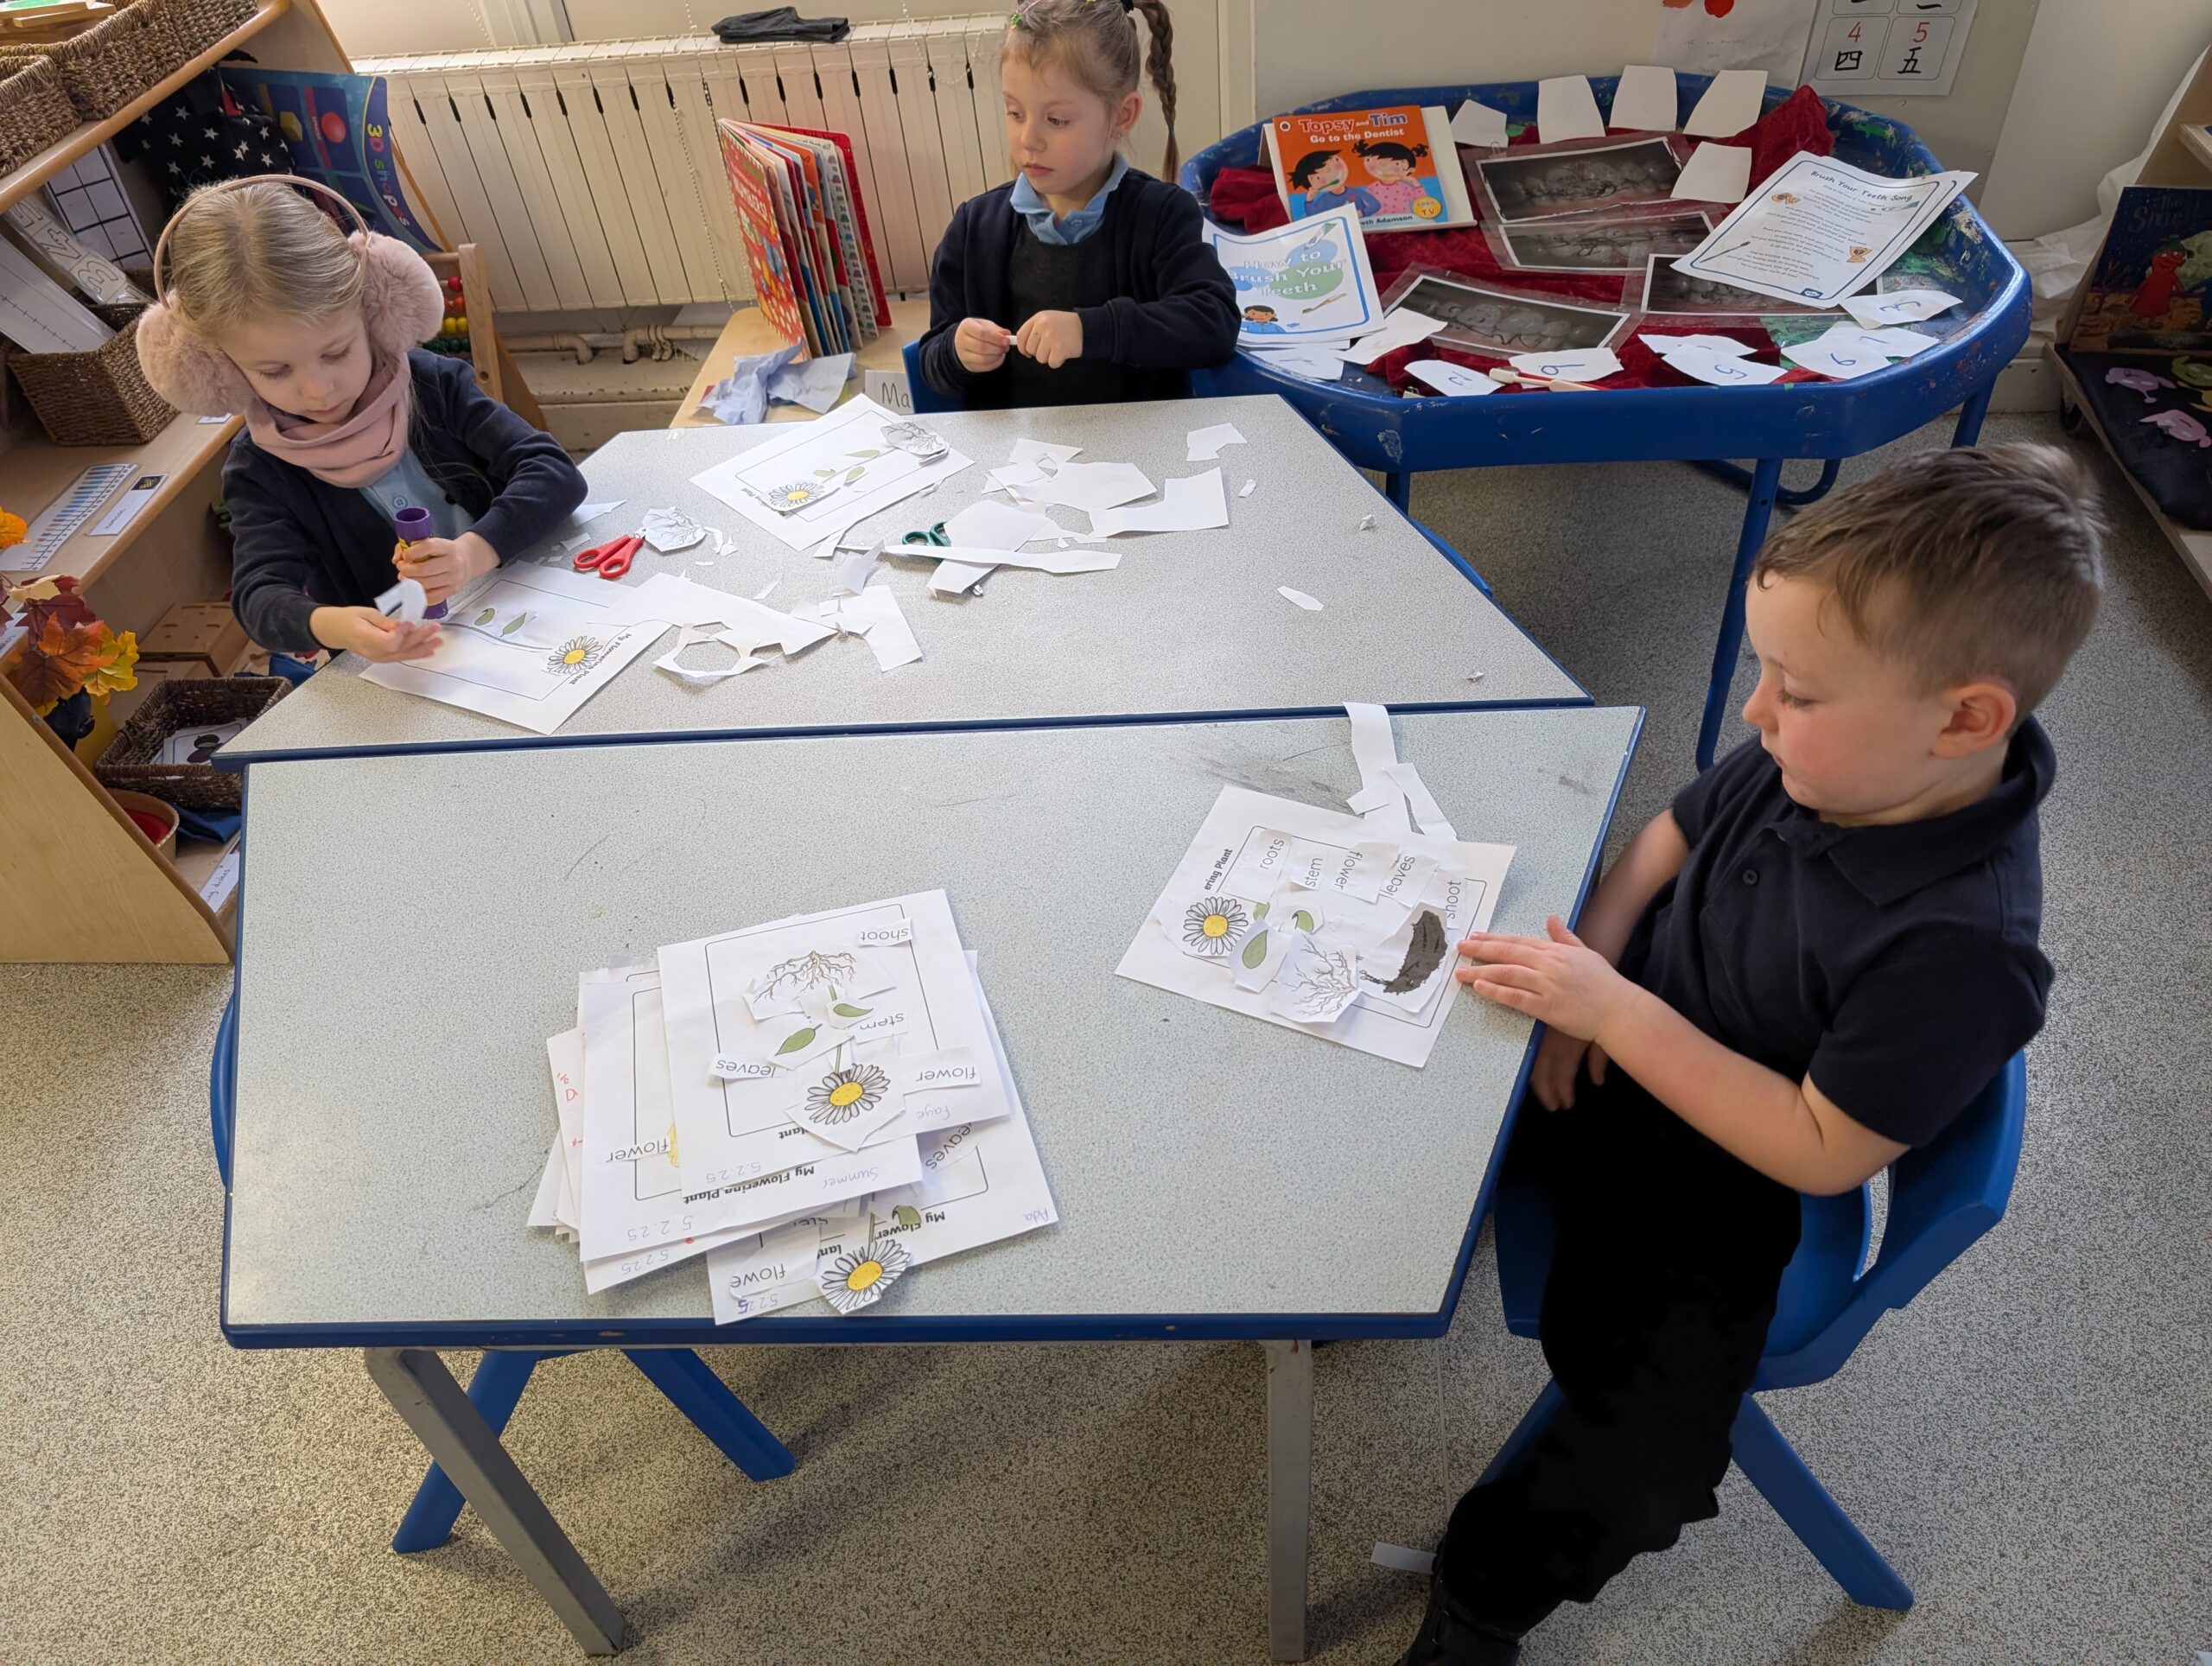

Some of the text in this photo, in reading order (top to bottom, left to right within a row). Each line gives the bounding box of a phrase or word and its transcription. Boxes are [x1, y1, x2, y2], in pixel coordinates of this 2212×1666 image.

[1847, 22, 1930, 43] 4 5
[1834, 47, 1923, 74] 四 五
[1299, 119, 1355, 134] Topsy
[1369, 113, 1408, 127] Tim
[367, 123, 385, 152] 3D
[1310, 128, 1405, 143] Go to the Dentist
[1810, 170, 1836, 183] Brush
[1838, 180, 1859, 192] Your
[1861, 190, 1887, 200] Teeth
[1891, 194, 1913, 203] Song
[1376, 215, 1413, 225] Adamson
[1244, 251, 1321, 270] How to
[1296, 259, 1348, 277] Your
[1262, 282, 1319, 296] Teeth
[1214, 848, 1233, 869] Plant
[1259, 838, 1285, 869] roots
[1304, 857, 1324, 887] stem
[1334, 849, 1363, 890] flower
[1379, 855, 1415, 895] leaves
[860, 927, 910, 942] shoot
[860, 1013, 905, 1030] stem
[715, 1059, 777, 1078] leaves
[916, 1065, 978, 1082] flower
[778, 1127, 810, 1140] lant
[605, 1137, 670, 1163] flower
[925, 1122, 972, 1169] eaves
[795, 1166, 815, 1177] My
[683, 1188, 721, 1205] Plant
[925, 1211, 946, 1223] My
[730, 1263, 787, 1288] flowe
